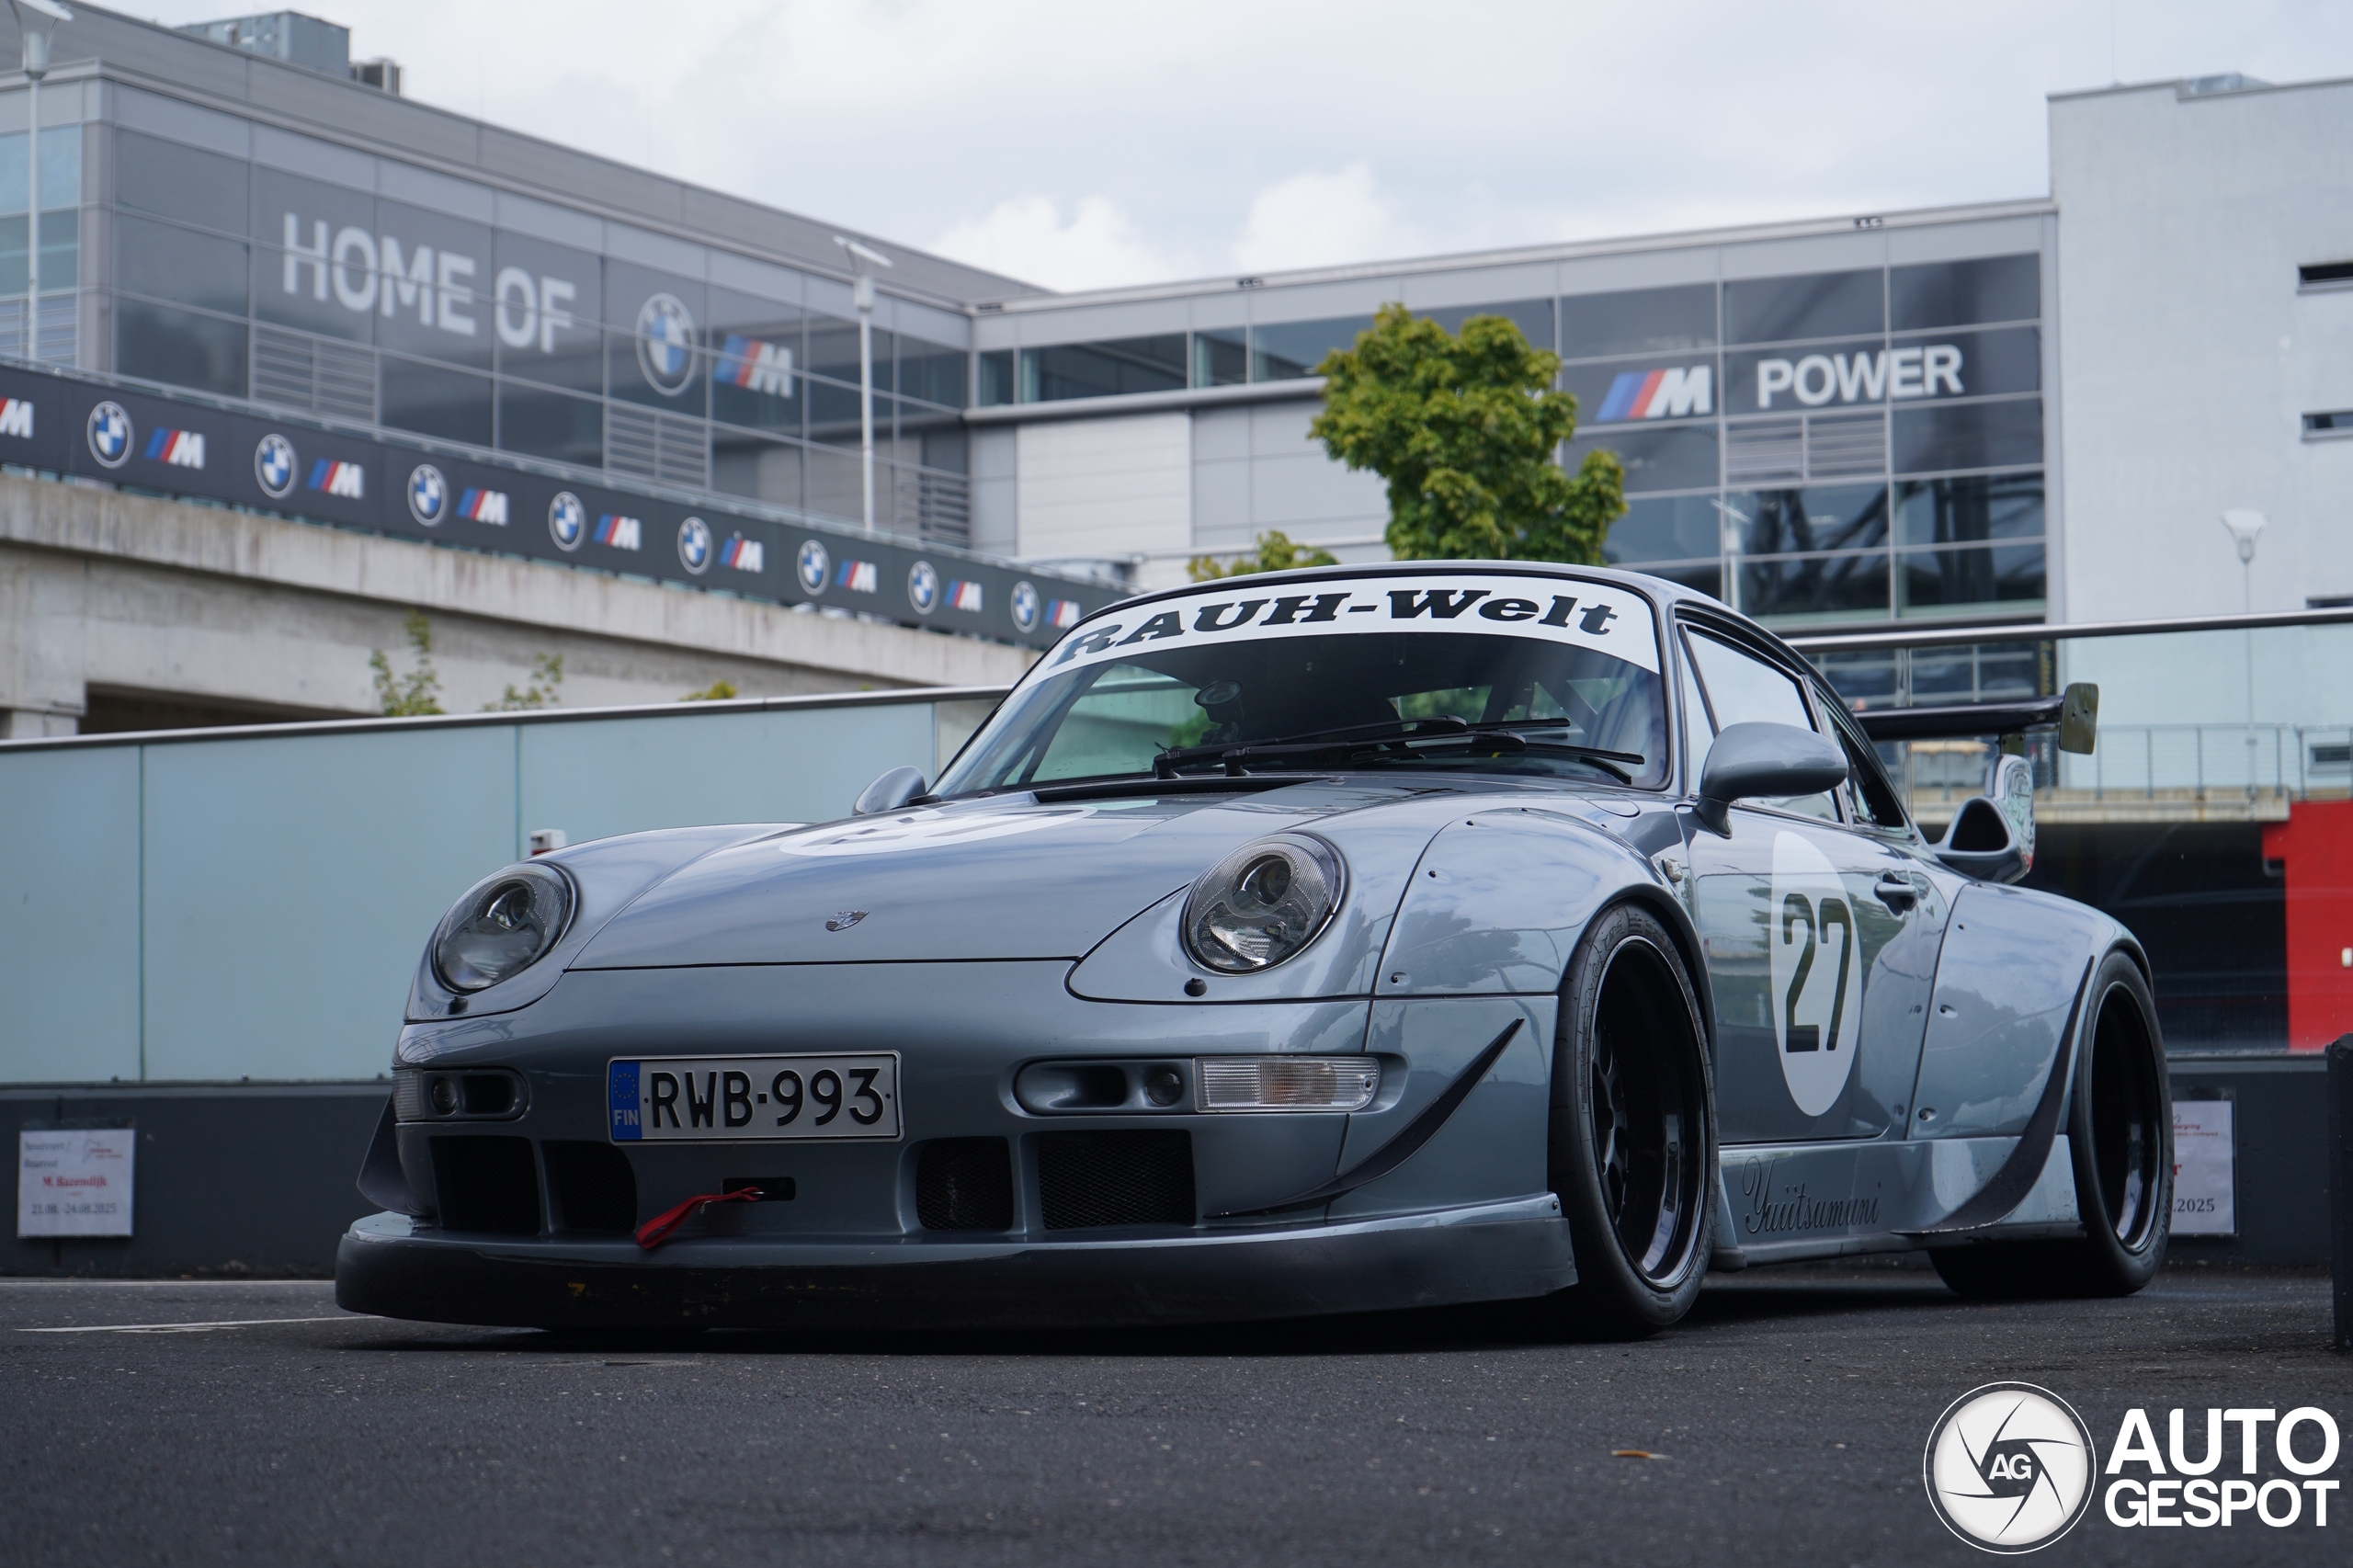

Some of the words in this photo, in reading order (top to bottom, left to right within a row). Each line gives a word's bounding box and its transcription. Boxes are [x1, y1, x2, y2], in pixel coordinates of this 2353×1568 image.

[282, 211, 476, 336] HOME
[494, 266, 575, 355] OF
[745, 340, 793, 398] M
[1643, 365, 1712, 418] M
[1756, 344, 1964, 410] POWER
[1047, 589, 1619, 671] RAUH-Welt
[1782, 892, 1852, 1053] 27
[613, 1108, 639, 1126] FIN
